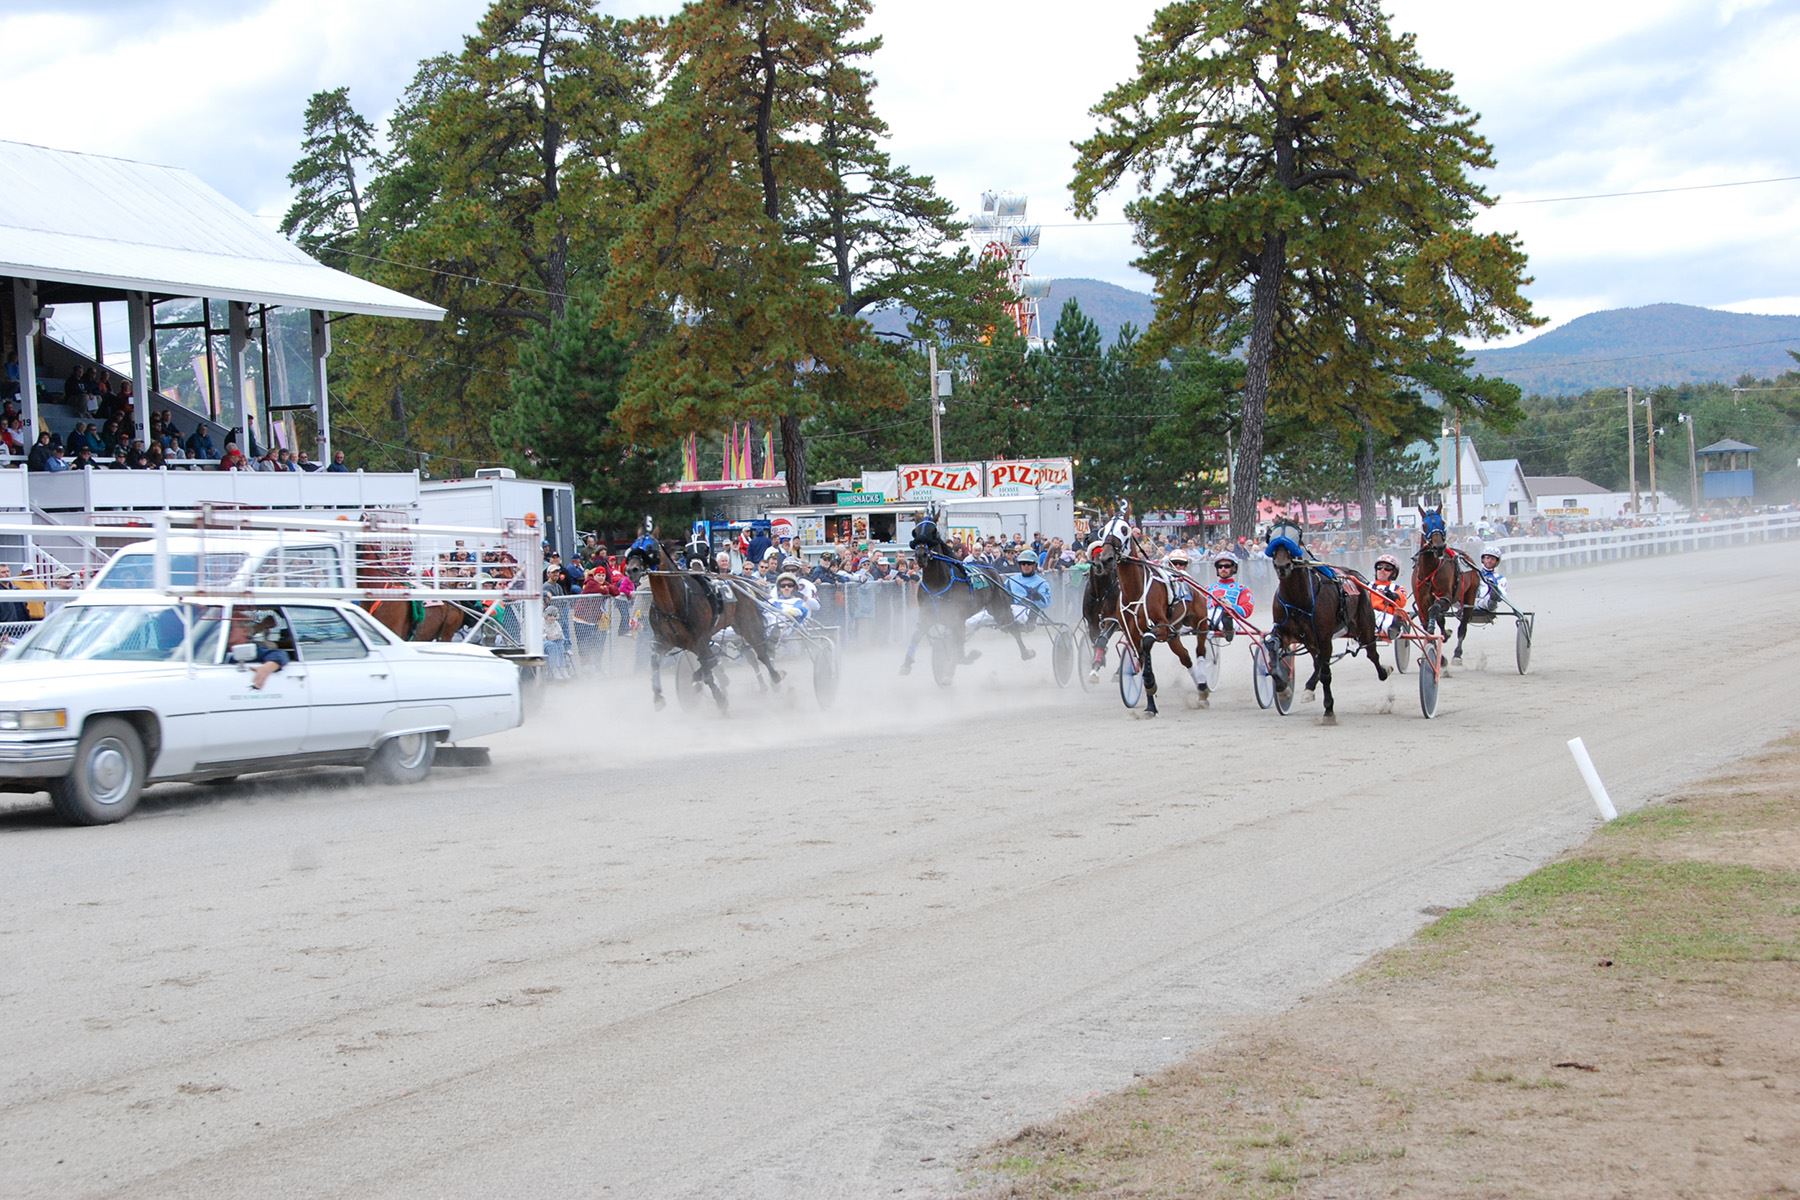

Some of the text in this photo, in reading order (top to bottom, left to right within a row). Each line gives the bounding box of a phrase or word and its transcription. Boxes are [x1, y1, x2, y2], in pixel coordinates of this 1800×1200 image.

[135, 422, 144, 431] 19
[903, 468, 978, 492] PIZZA
[1039, 467, 1068, 484] PIZZA
[852, 494, 881, 505] SNACKS
[1120, 498, 1128, 514] 2
[646, 515, 653, 532] 5
